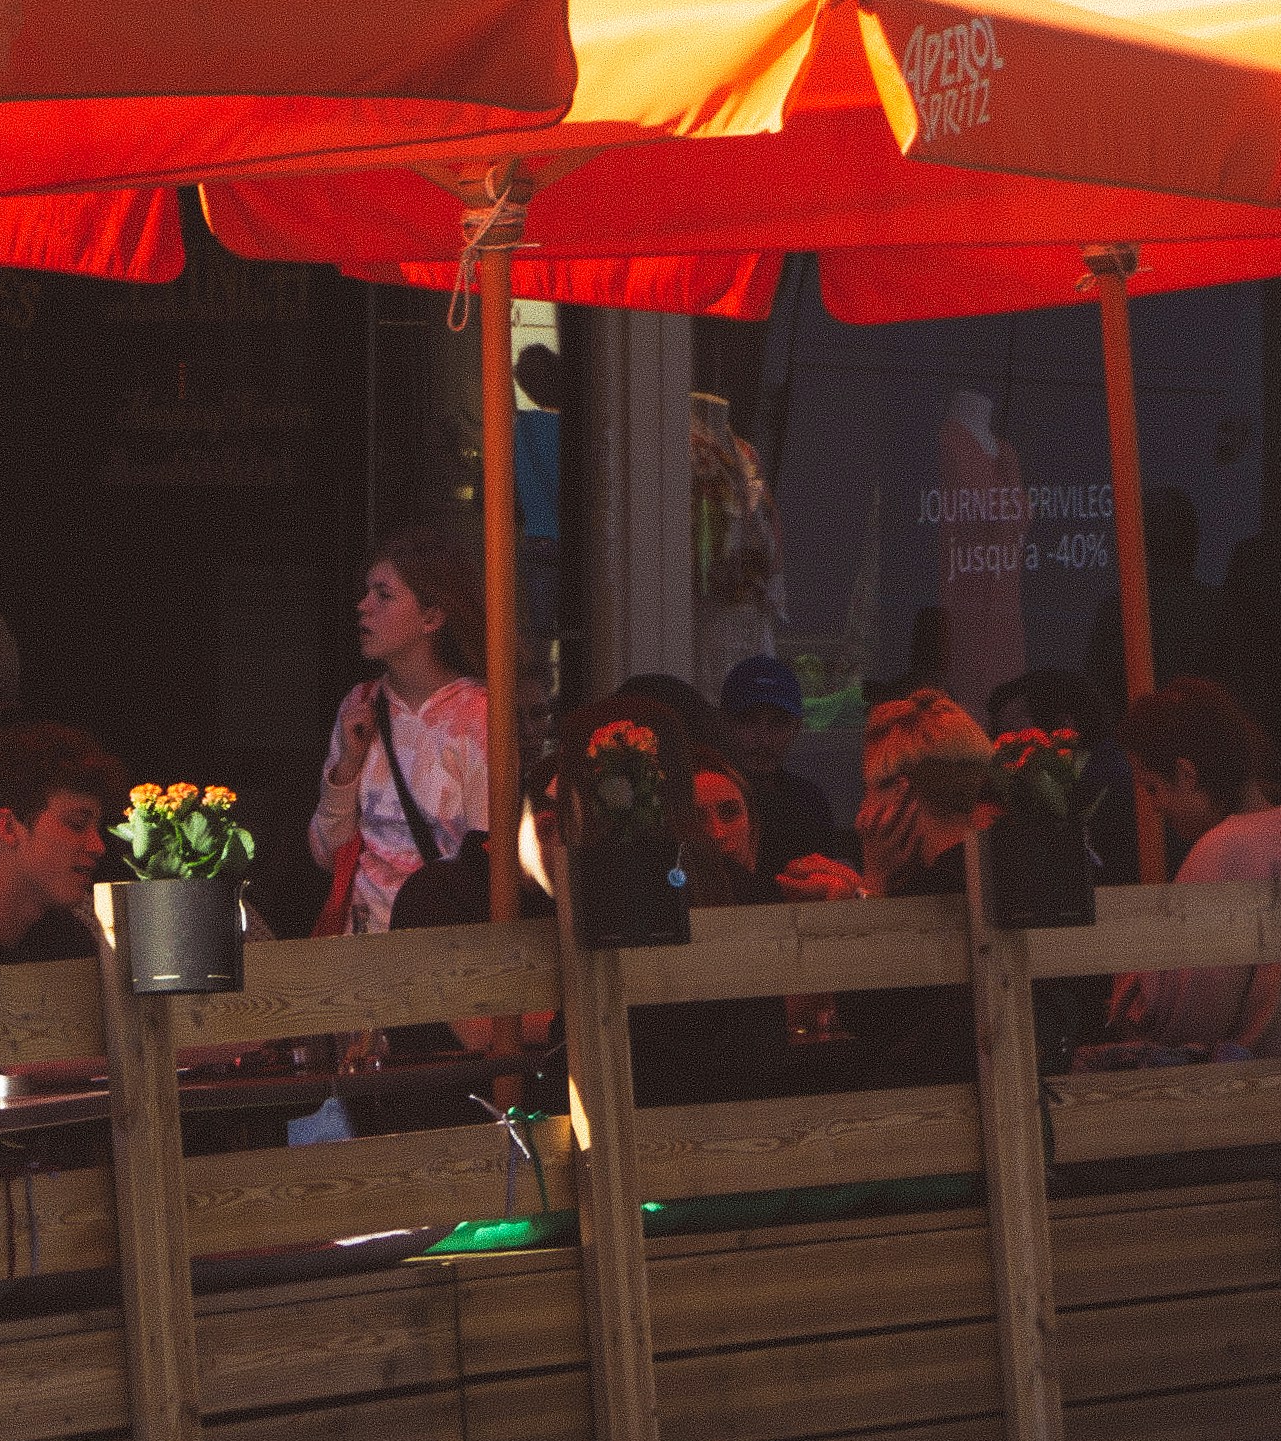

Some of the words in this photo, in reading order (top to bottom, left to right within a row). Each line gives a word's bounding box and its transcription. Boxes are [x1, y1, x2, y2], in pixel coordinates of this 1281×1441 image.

[901, 15, 1006, 104] APEROL
[916, 486, 1023, 524] JOURNEES
[1045, 531, 1109, 569] -40%
